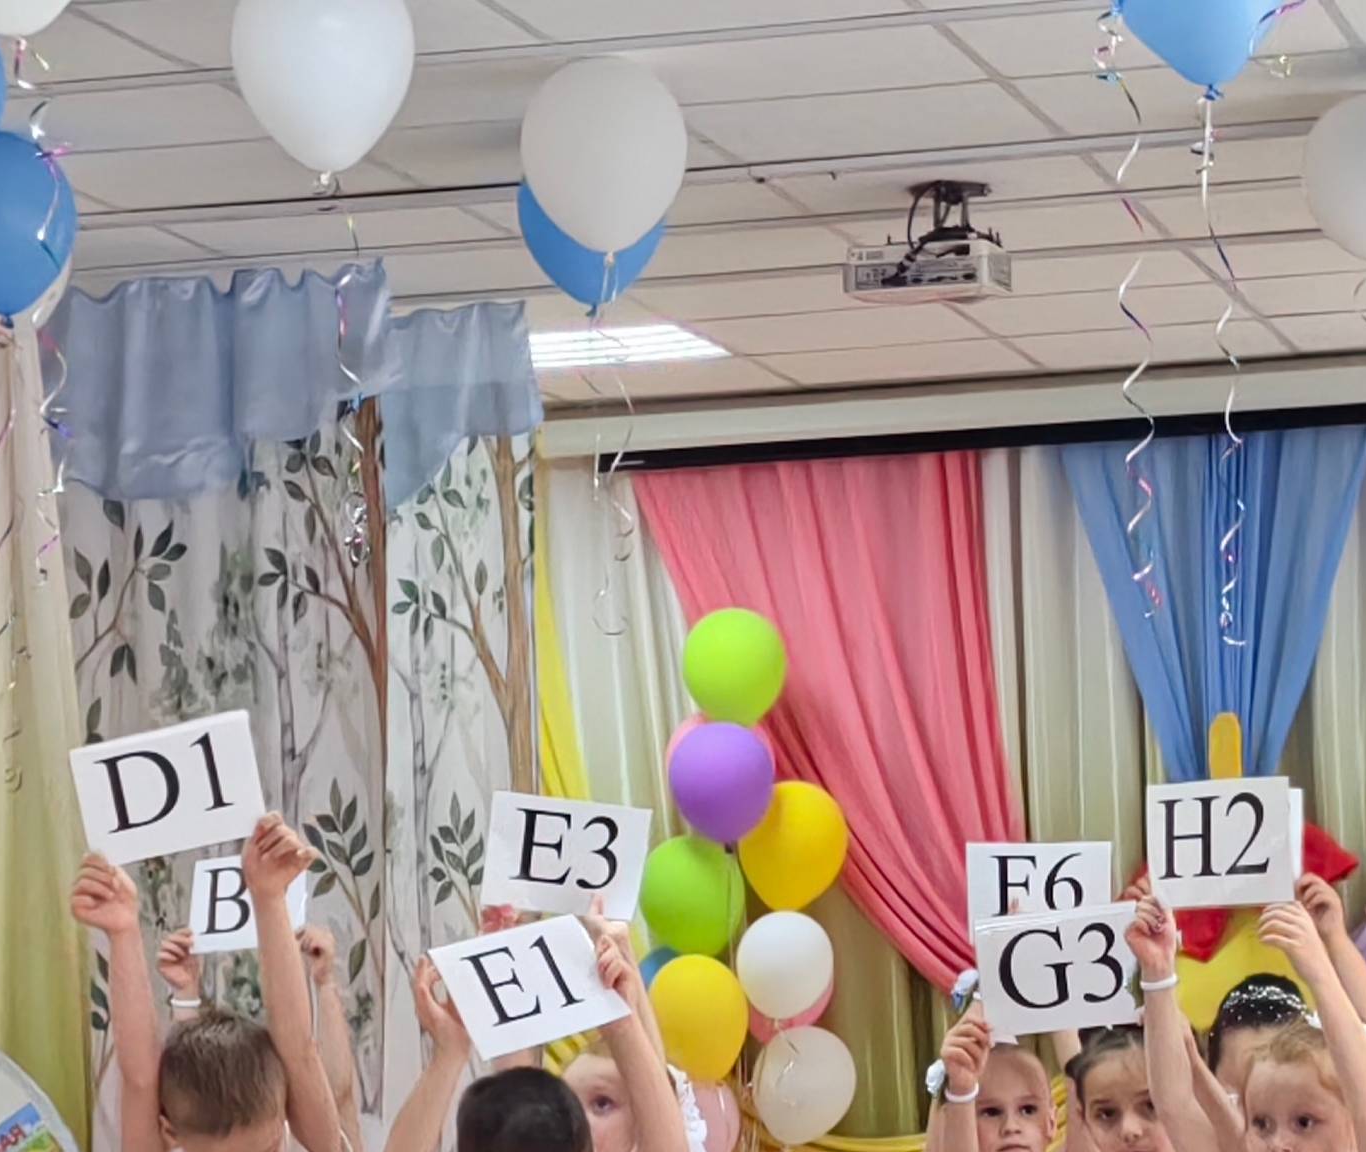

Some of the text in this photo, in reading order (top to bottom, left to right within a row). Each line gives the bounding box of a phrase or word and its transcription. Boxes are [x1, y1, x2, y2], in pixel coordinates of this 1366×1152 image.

[94, 732, 233, 834] D1
[515, 808, 618, 890] E3
[1158, 792, 1270, 880] H2
[200, 866, 251, 935] B
[990, 852, 1084, 917] F6
[461, 936, 584, 1028] E1
[998, 921, 1124, 1009] G3
